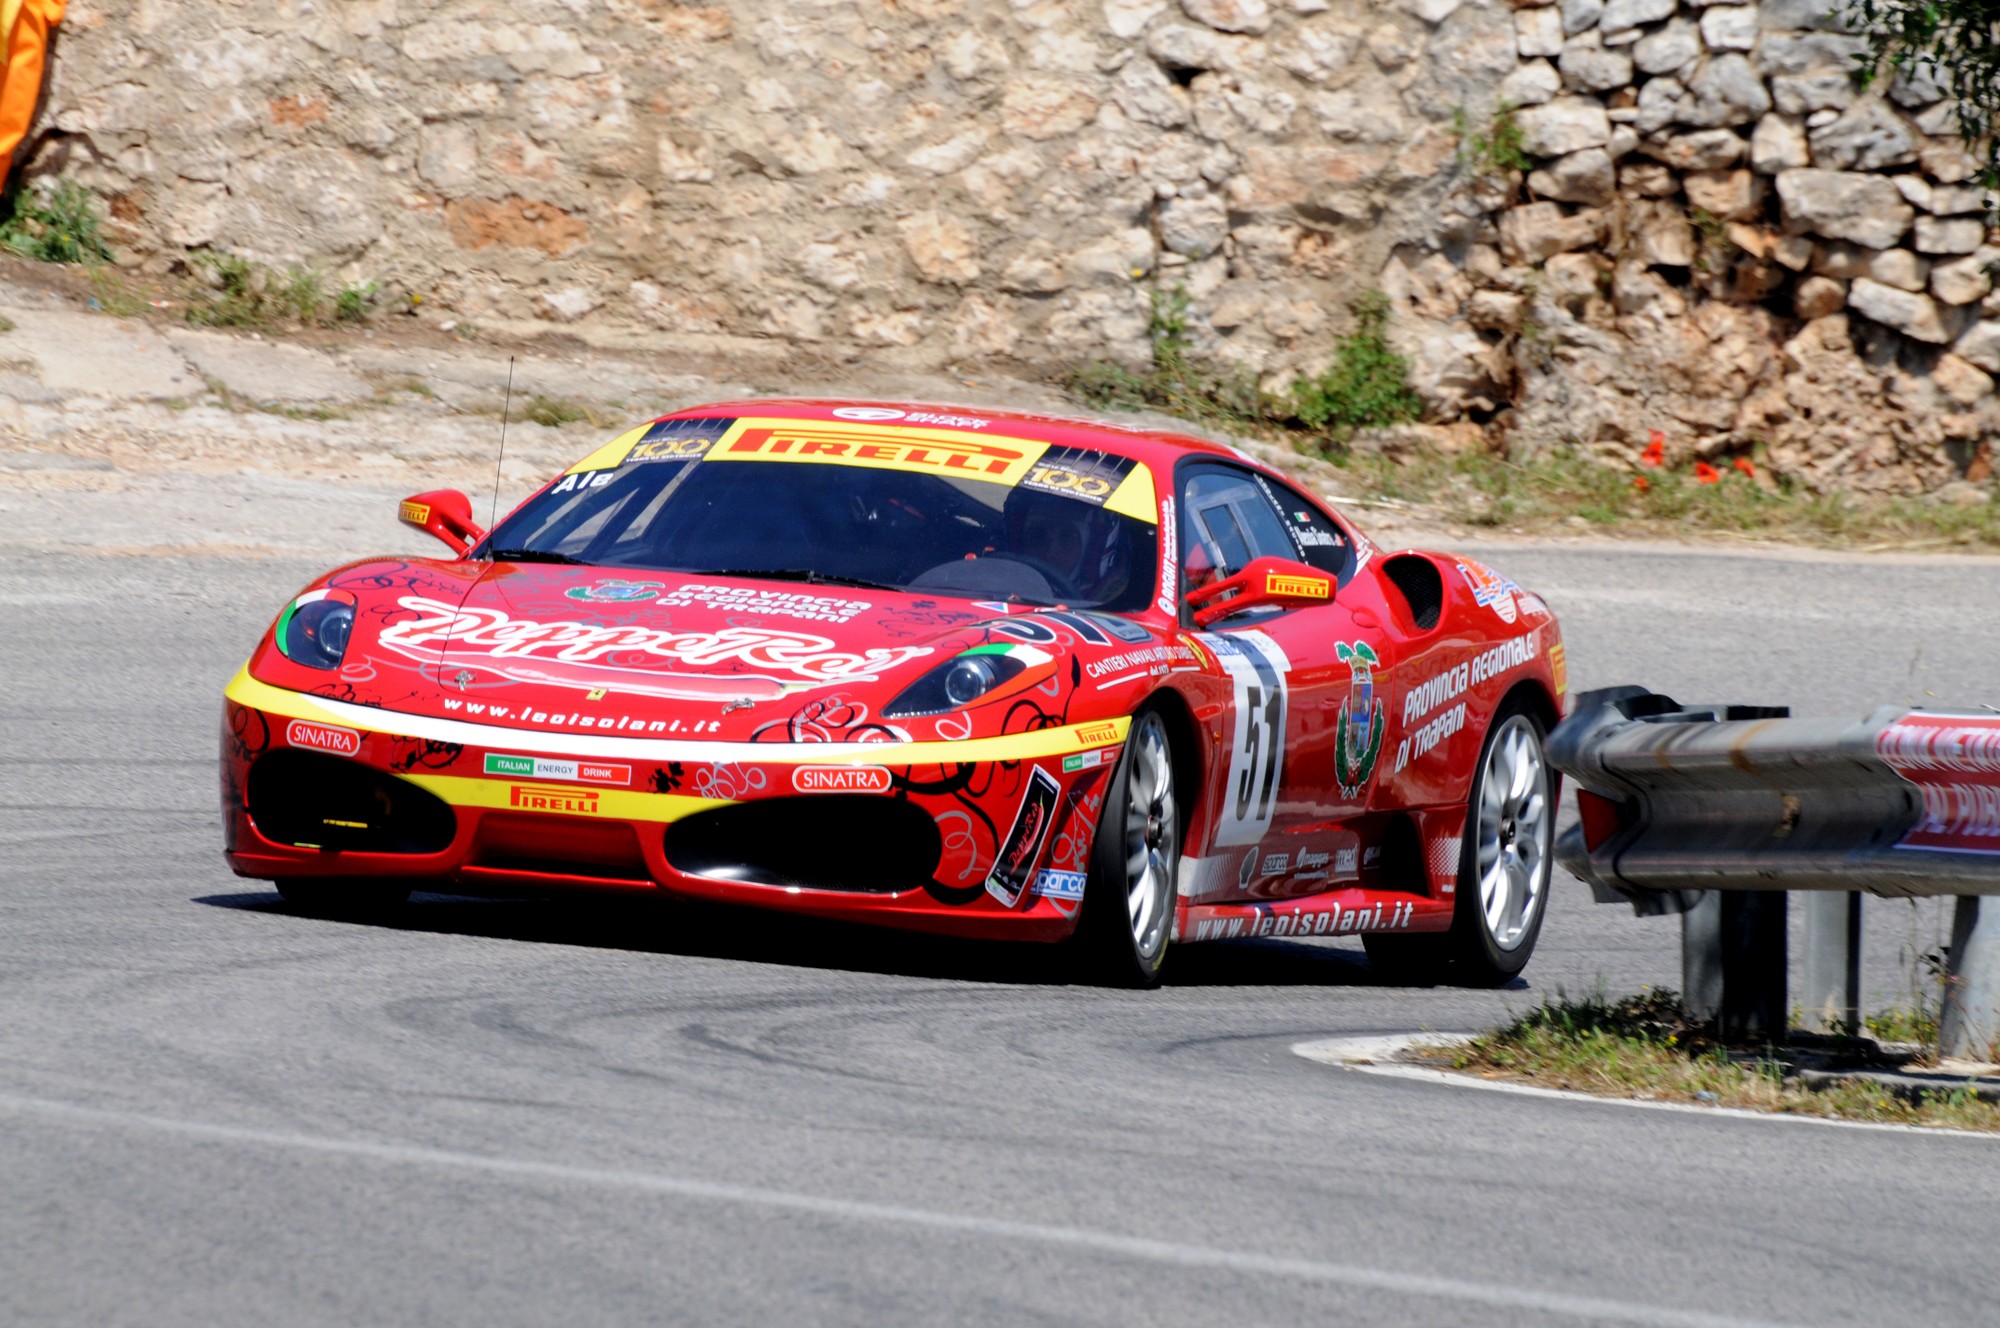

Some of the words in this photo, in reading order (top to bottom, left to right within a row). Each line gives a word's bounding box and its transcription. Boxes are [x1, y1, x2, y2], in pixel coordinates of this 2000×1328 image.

[727, 428, 1024, 475] PIRELLI
[1030, 467, 1111, 496] 100
[679, 584, 872, 611] PROVINCIA
[1269, 578, 1327, 597] PIRELLI
[656, 598, 692, 607] DI
[706, 601, 850, 624] TRAPANI
[667, 591, 861, 617] REGIONALE
[1086, 656, 1128, 678] CANTIERI
[1402, 661, 1469, 729] PROVINCIA
[1471, 632, 1535, 687] REGIONALE
[293, 725, 352, 751] SINATRA
[1074, 723, 1119, 744] PIRELLI
[1394, 736, 1411, 775] DI
[1414, 701, 1467, 760] TRAPANI
[1235, 685, 1282, 822] 51
[497, 759, 531, 772] ITALIAN
[537, 763, 574, 775] ENERGY
[583, 767, 612, 779] DRINK
[803, 771, 880, 788] SINATRA
[510, 785, 600, 813] PIRELLI
[1196, 901, 1414, 942] www.leoisolani.it
